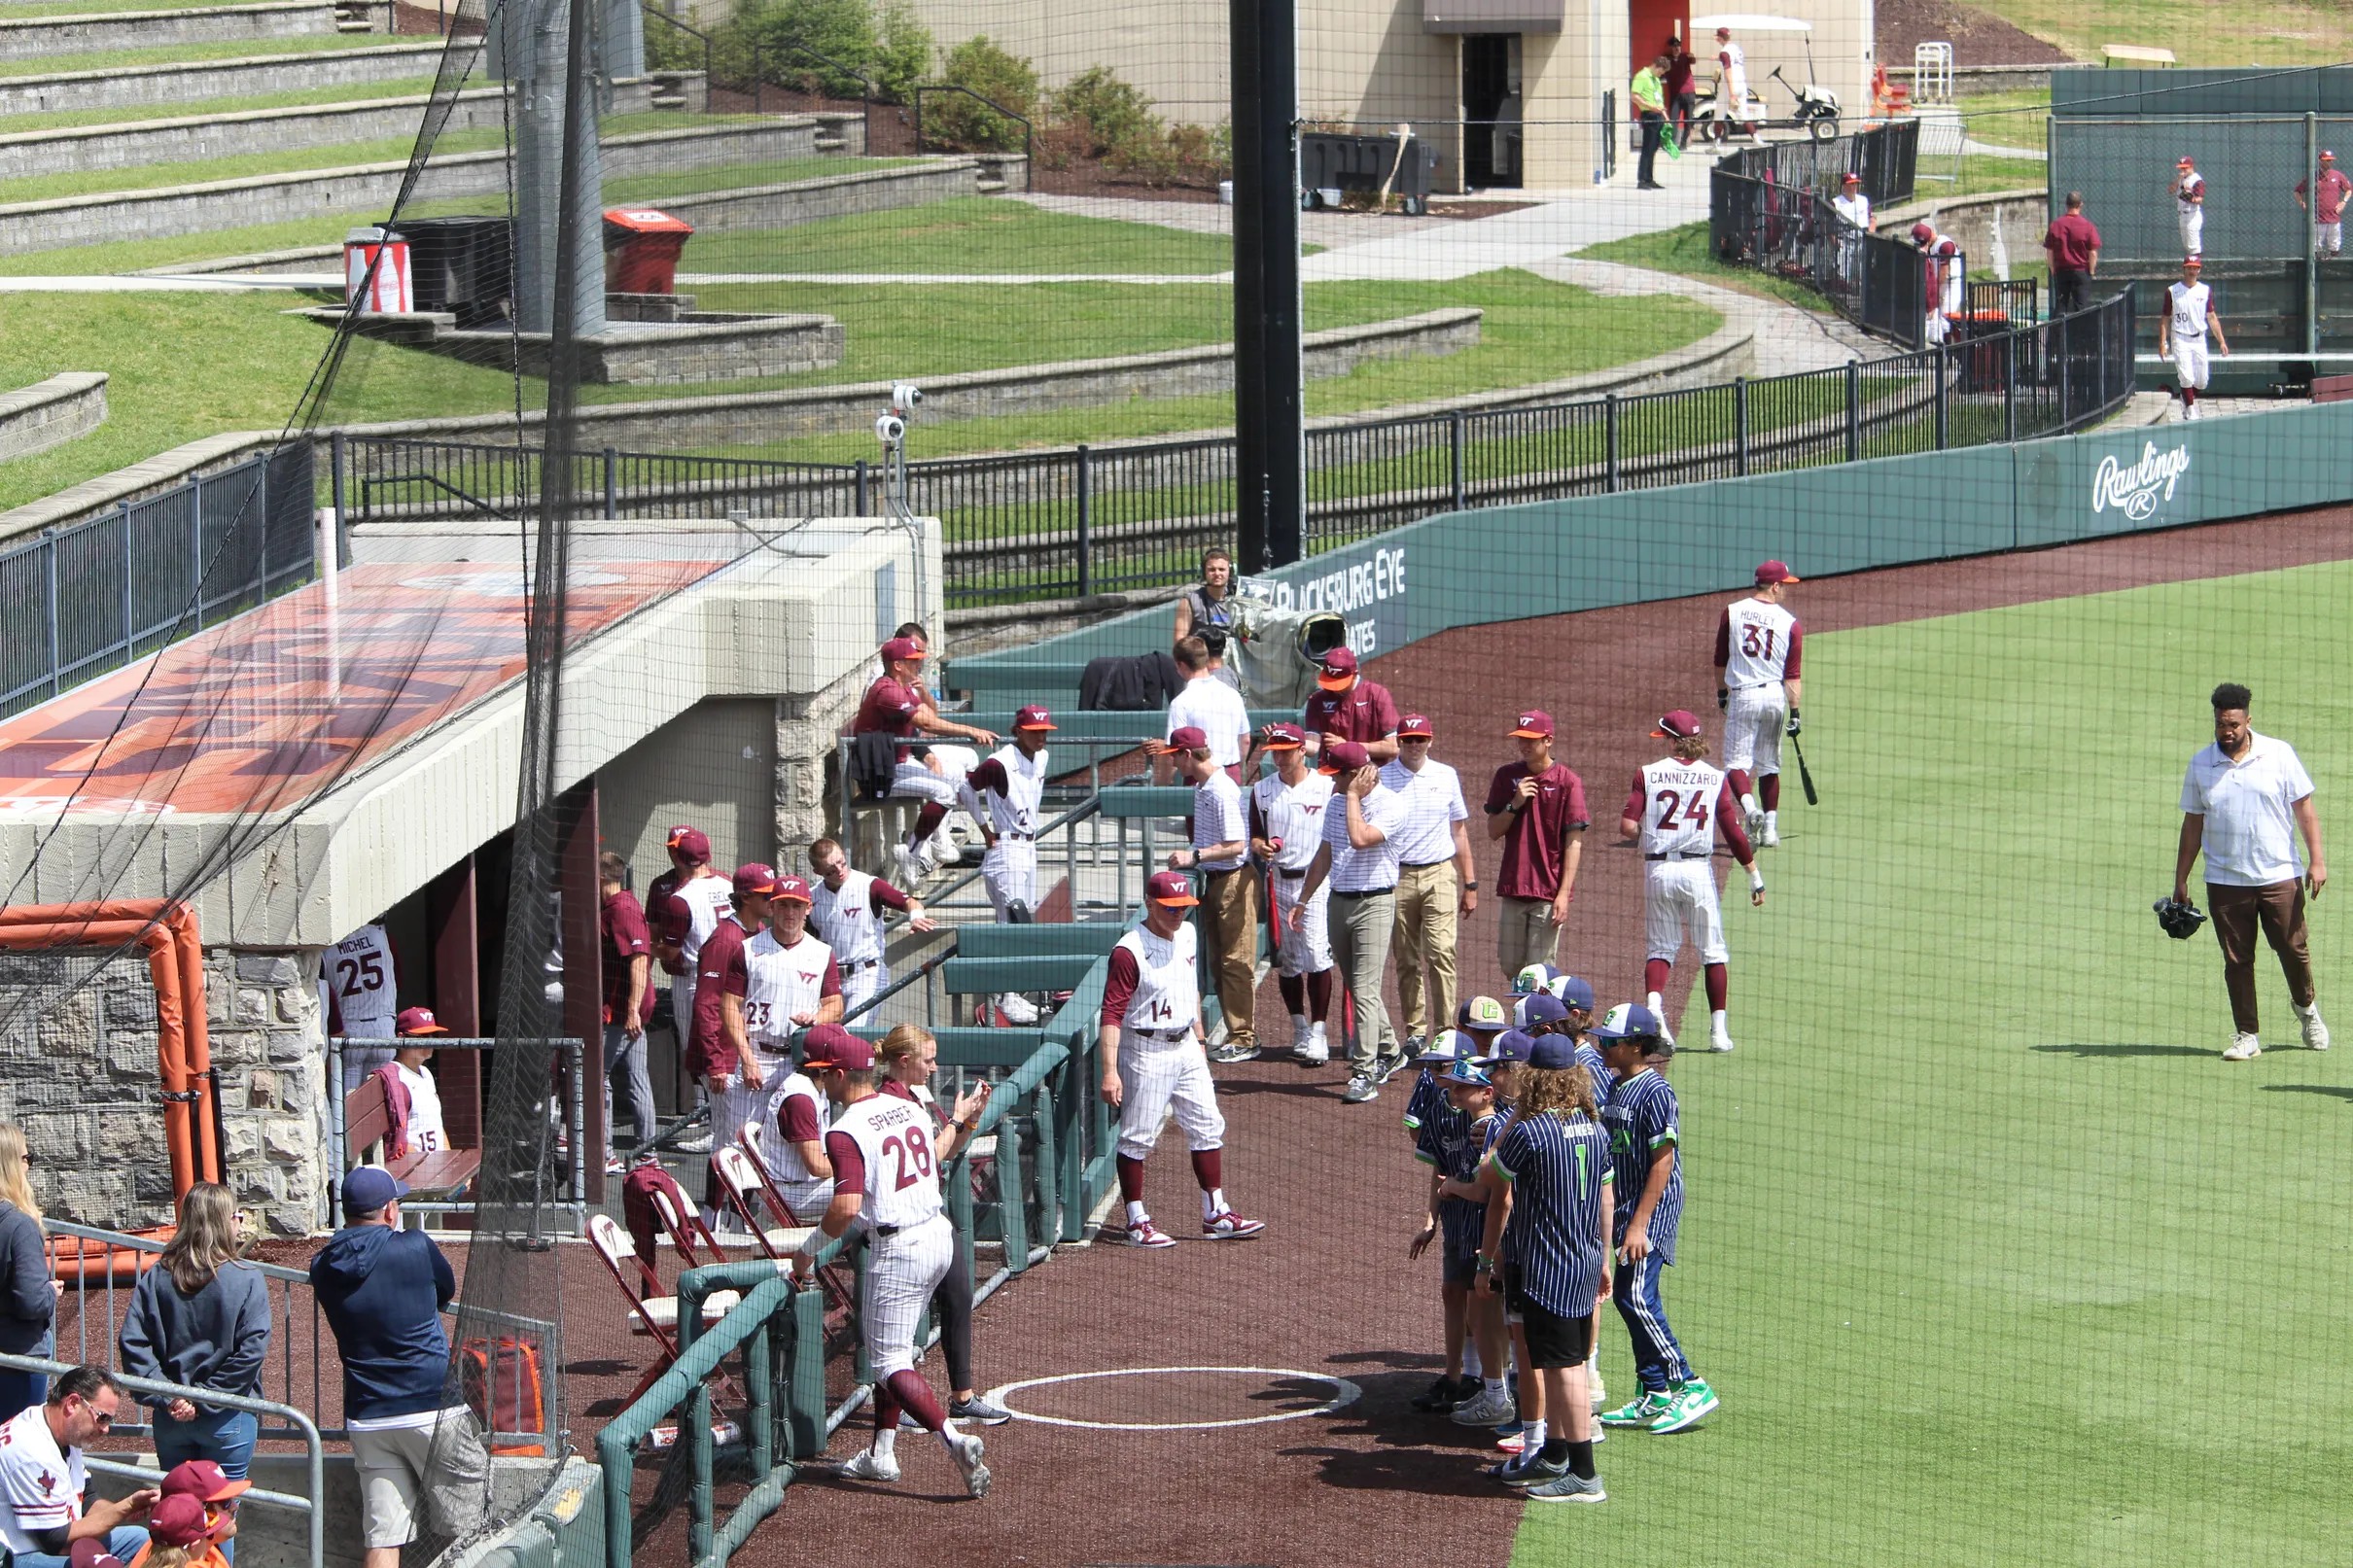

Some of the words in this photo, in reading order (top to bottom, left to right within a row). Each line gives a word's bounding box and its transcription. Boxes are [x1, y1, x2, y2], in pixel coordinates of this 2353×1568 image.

[2175, 313, 2188, 323] 30
[2092, 440, 2190, 513] Rawlings
[1375, 547, 1405, 600] EYE
[1740, 610, 1775, 626] HURLEY
[1741, 623, 1774, 661] 31
[1033, 712, 1048, 721] VT
[1405, 718, 1422, 728] VT
[1520, 716, 1534, 726] VT
[1650, 772, 1718, 786] CANNIZZARO
[1302, 804, 1322, 816] VT
[1656, 789, 1708, 831] 24
[781, 880, 800, 890] VT
[1170, 881, 1186, 892] VT
[844, 907, 862, 919] VT
[336, 935, 374, 956] MICHEL
[336, 950, 385, 998] 25
[797, 969, 819, 985] VT
[419, 1011, 434, 1022] VT
[746, 1001, 772, 1026] 23
[1150, 997, 1172, 1023] 14
[1481, 1001, 1498, 1019] C
[867, 1104, 915, 1132] SPARBER
[1563, 1122, 1596, 1139] JONES
[418, 1131, 437, 1152] 15
[882, 1125, 931, 1193] 28
[1575, 1143, 1587, 1201] 1
